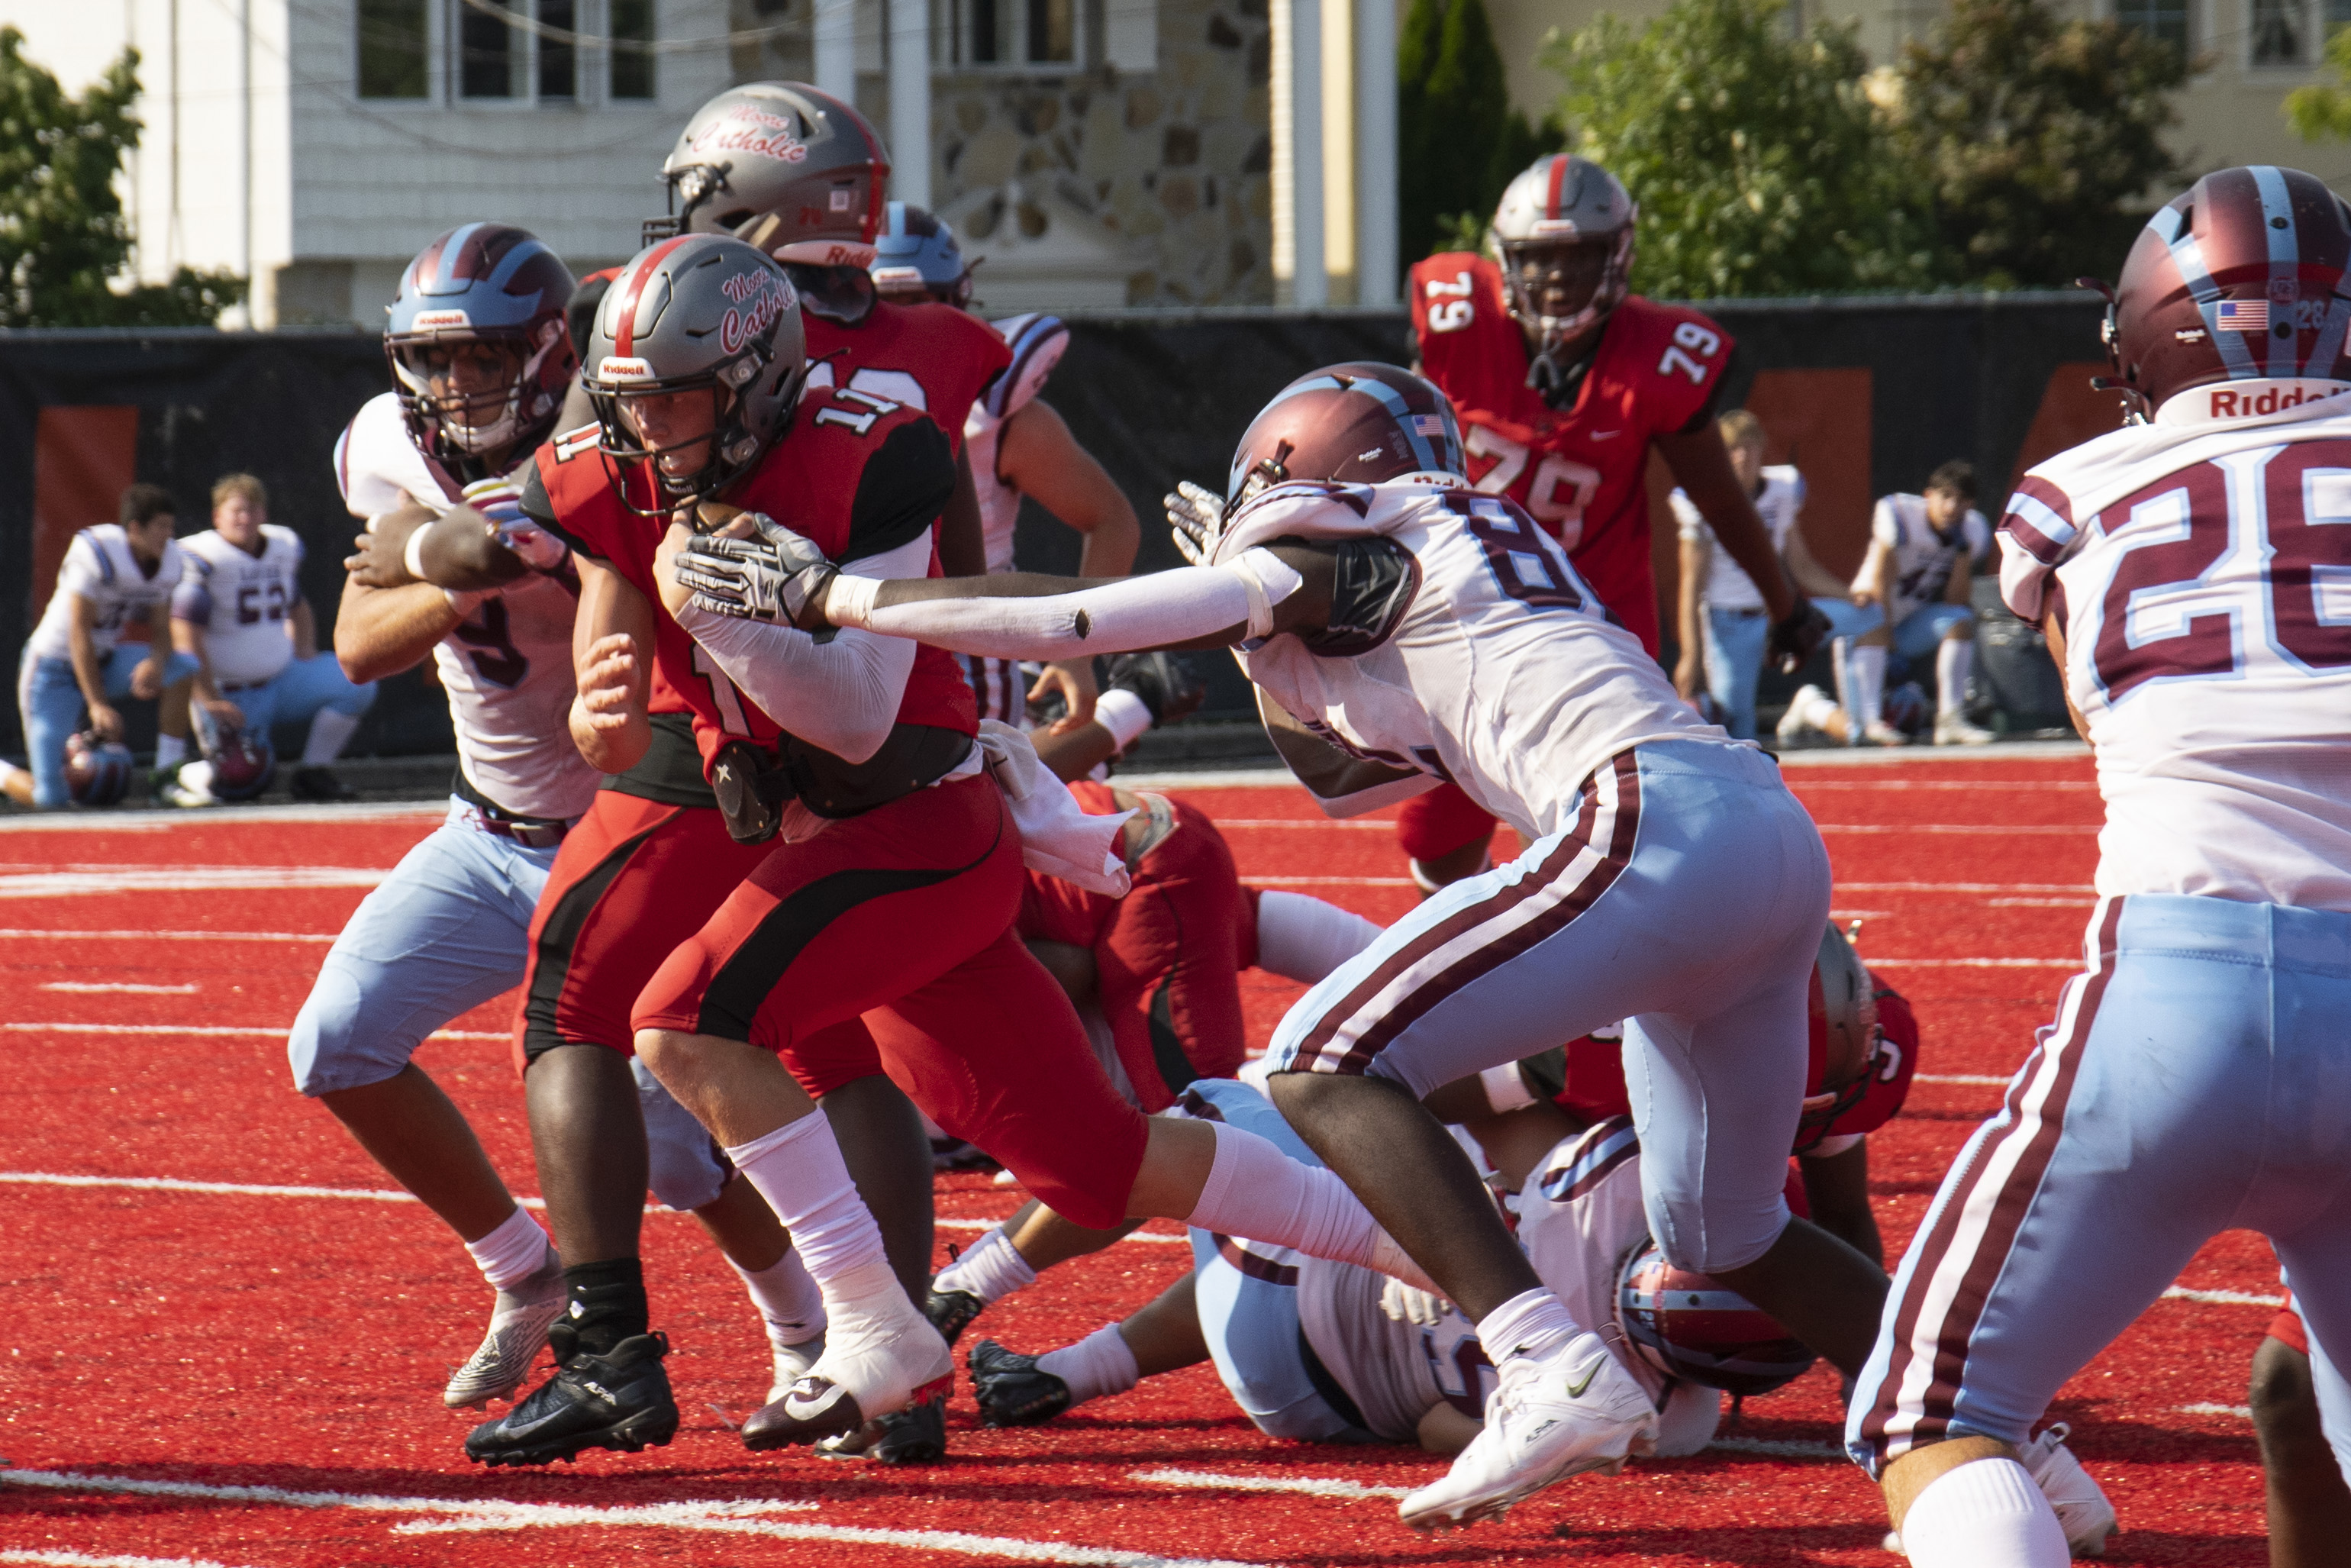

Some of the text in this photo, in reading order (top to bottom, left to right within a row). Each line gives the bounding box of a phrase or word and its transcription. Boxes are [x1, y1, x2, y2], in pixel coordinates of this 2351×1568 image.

[2295, 299, 2325, 329] 28
[603, 363, 644, 375] Riddell
[1658, 321, 1721, 384] 79
[813, 388, 902, 437] 11
[2210, 387, 2351, 419] Ridd
[1464, 423, 1602, 556] 79
